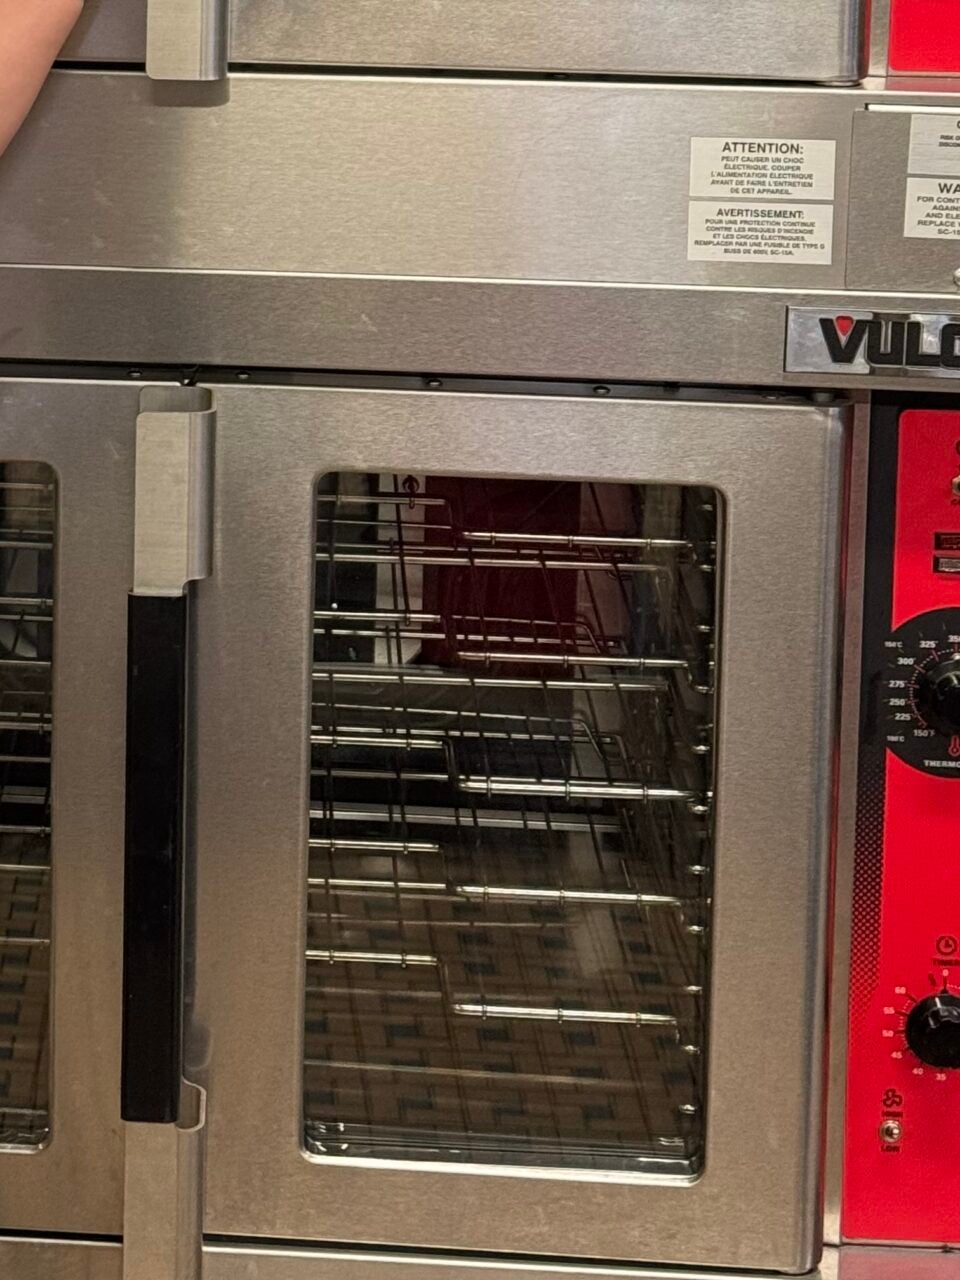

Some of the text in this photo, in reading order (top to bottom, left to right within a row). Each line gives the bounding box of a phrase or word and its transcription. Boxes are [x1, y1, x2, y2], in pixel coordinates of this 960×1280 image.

[722, 142, 804, 154] ATTENTION:
[716, 208, 804, 219] AVERTISSEMENT:
[891, 1051, 903, 1059] 45
